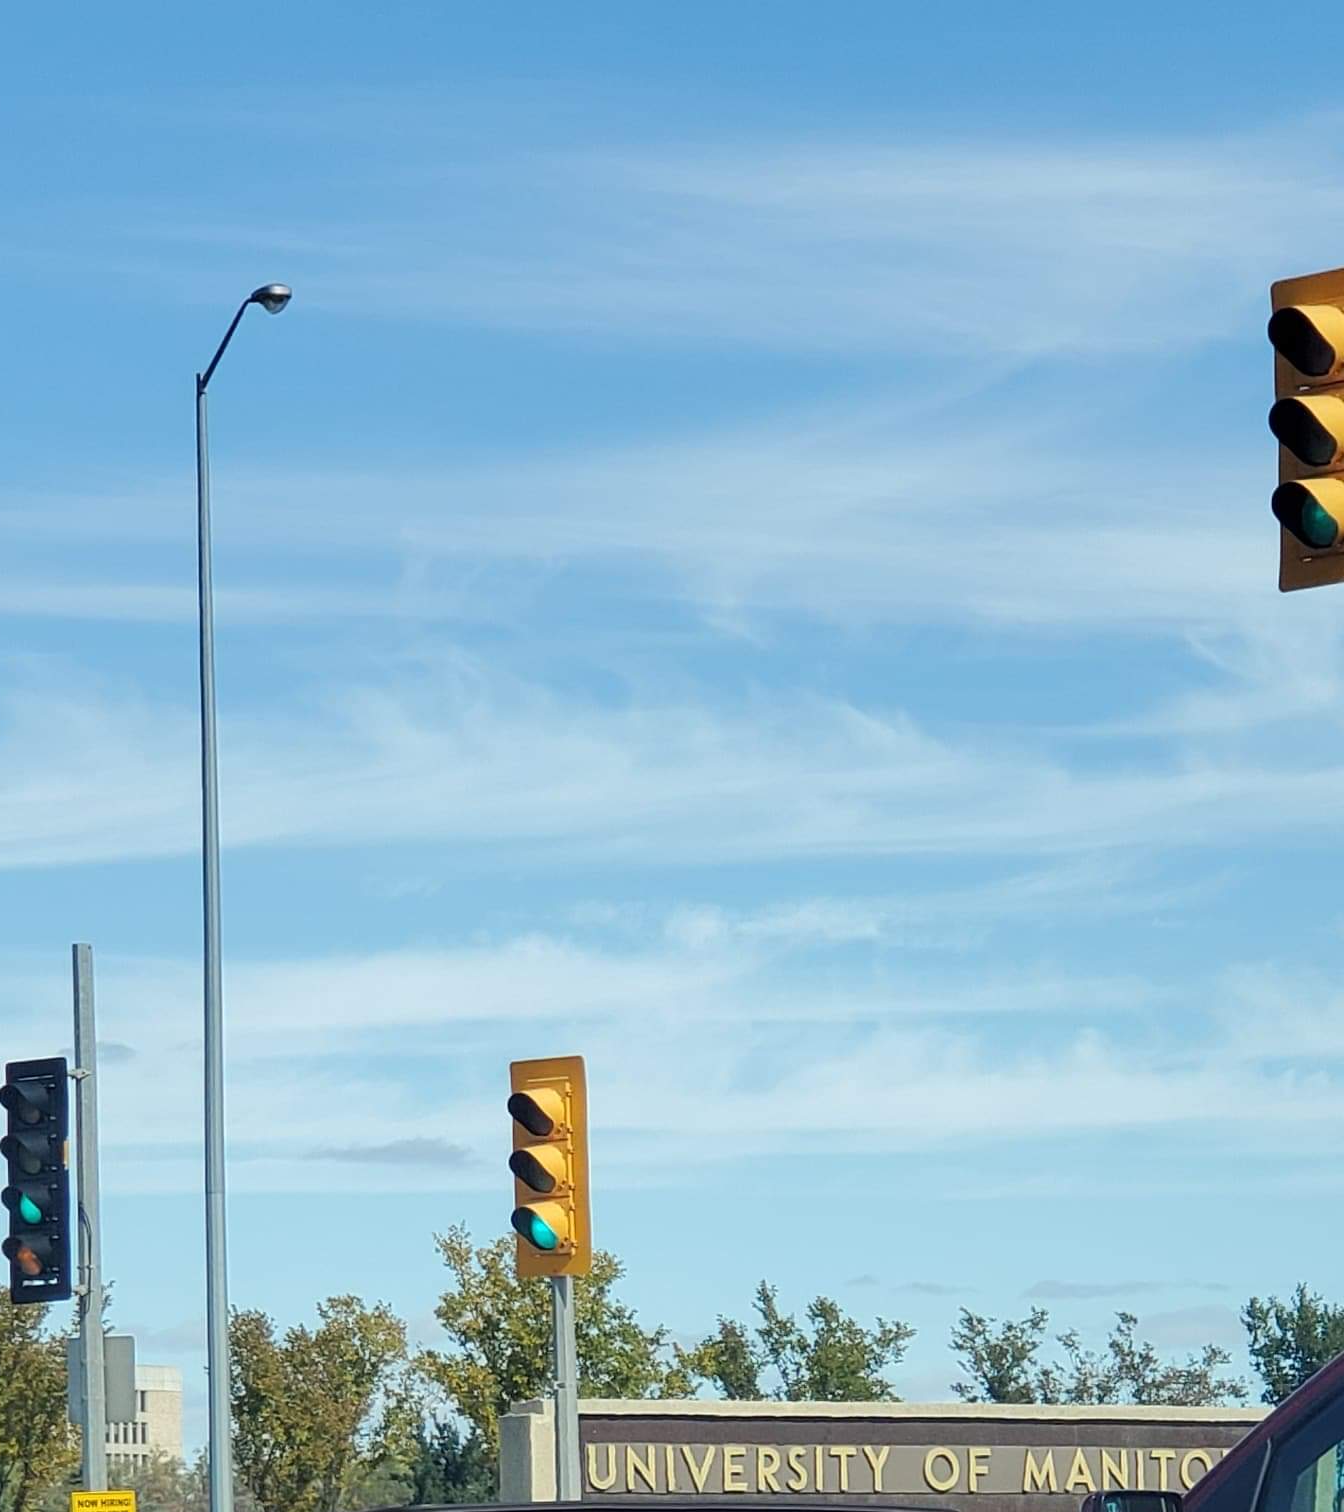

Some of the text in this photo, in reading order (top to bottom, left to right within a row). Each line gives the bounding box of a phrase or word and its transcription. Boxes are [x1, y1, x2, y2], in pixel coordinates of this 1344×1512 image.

[586, 1444, 1233, 1493] UNIVERSITY OF MANITO
[77, 1499, 97, 1508] NOW
